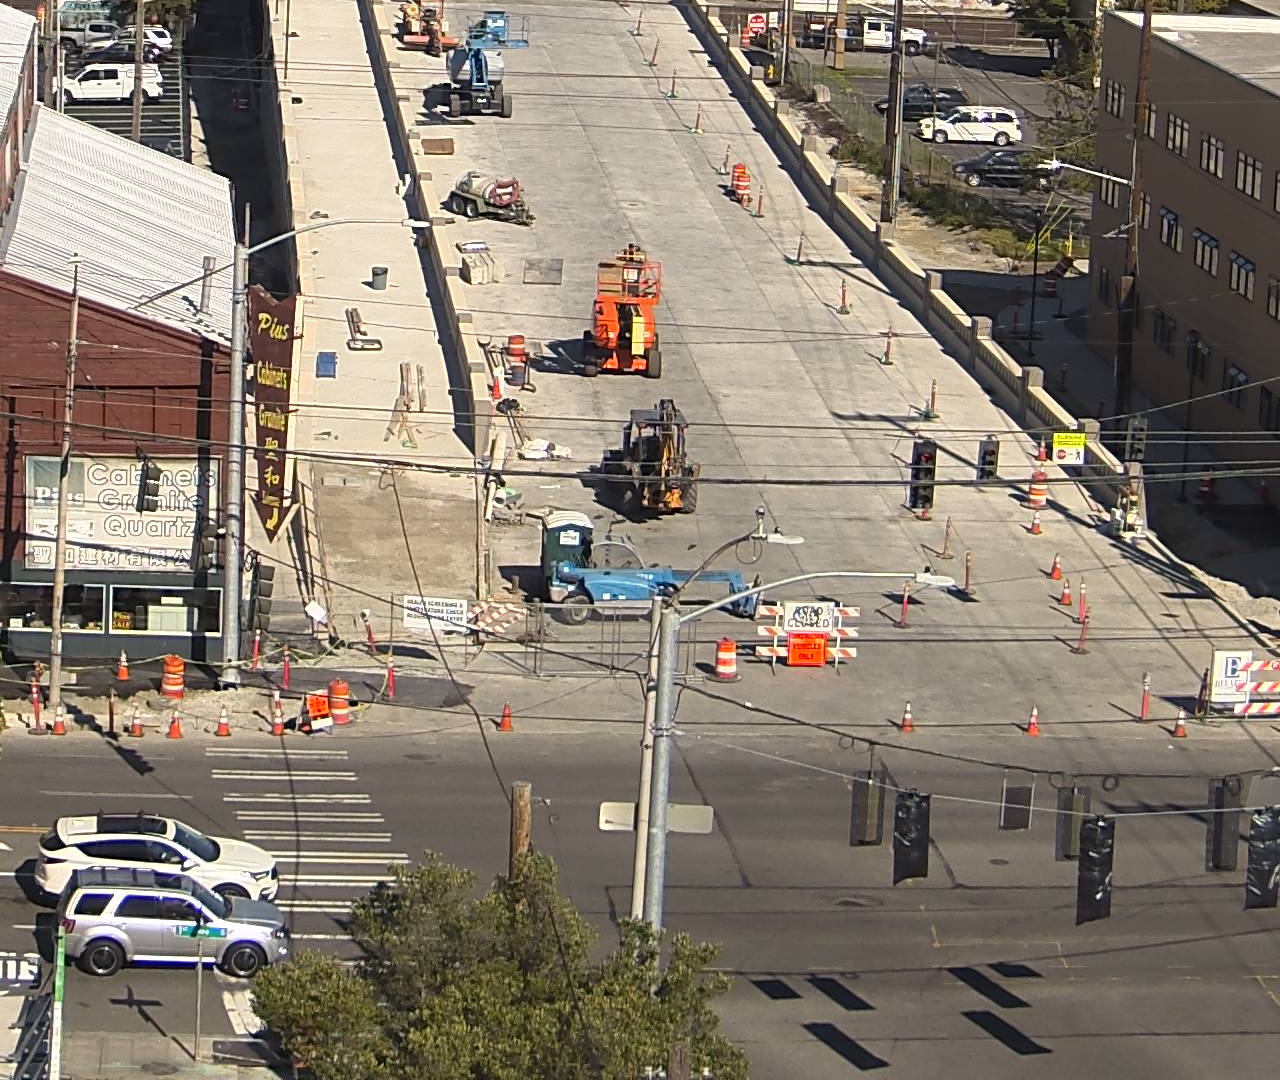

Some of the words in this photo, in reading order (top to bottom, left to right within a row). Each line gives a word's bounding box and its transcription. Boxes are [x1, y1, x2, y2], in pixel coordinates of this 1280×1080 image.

[257, 312, 289, 340] Pius
[87, 463, 216, 487] Cabnets
[104, 514, 197, 538] Quartz
